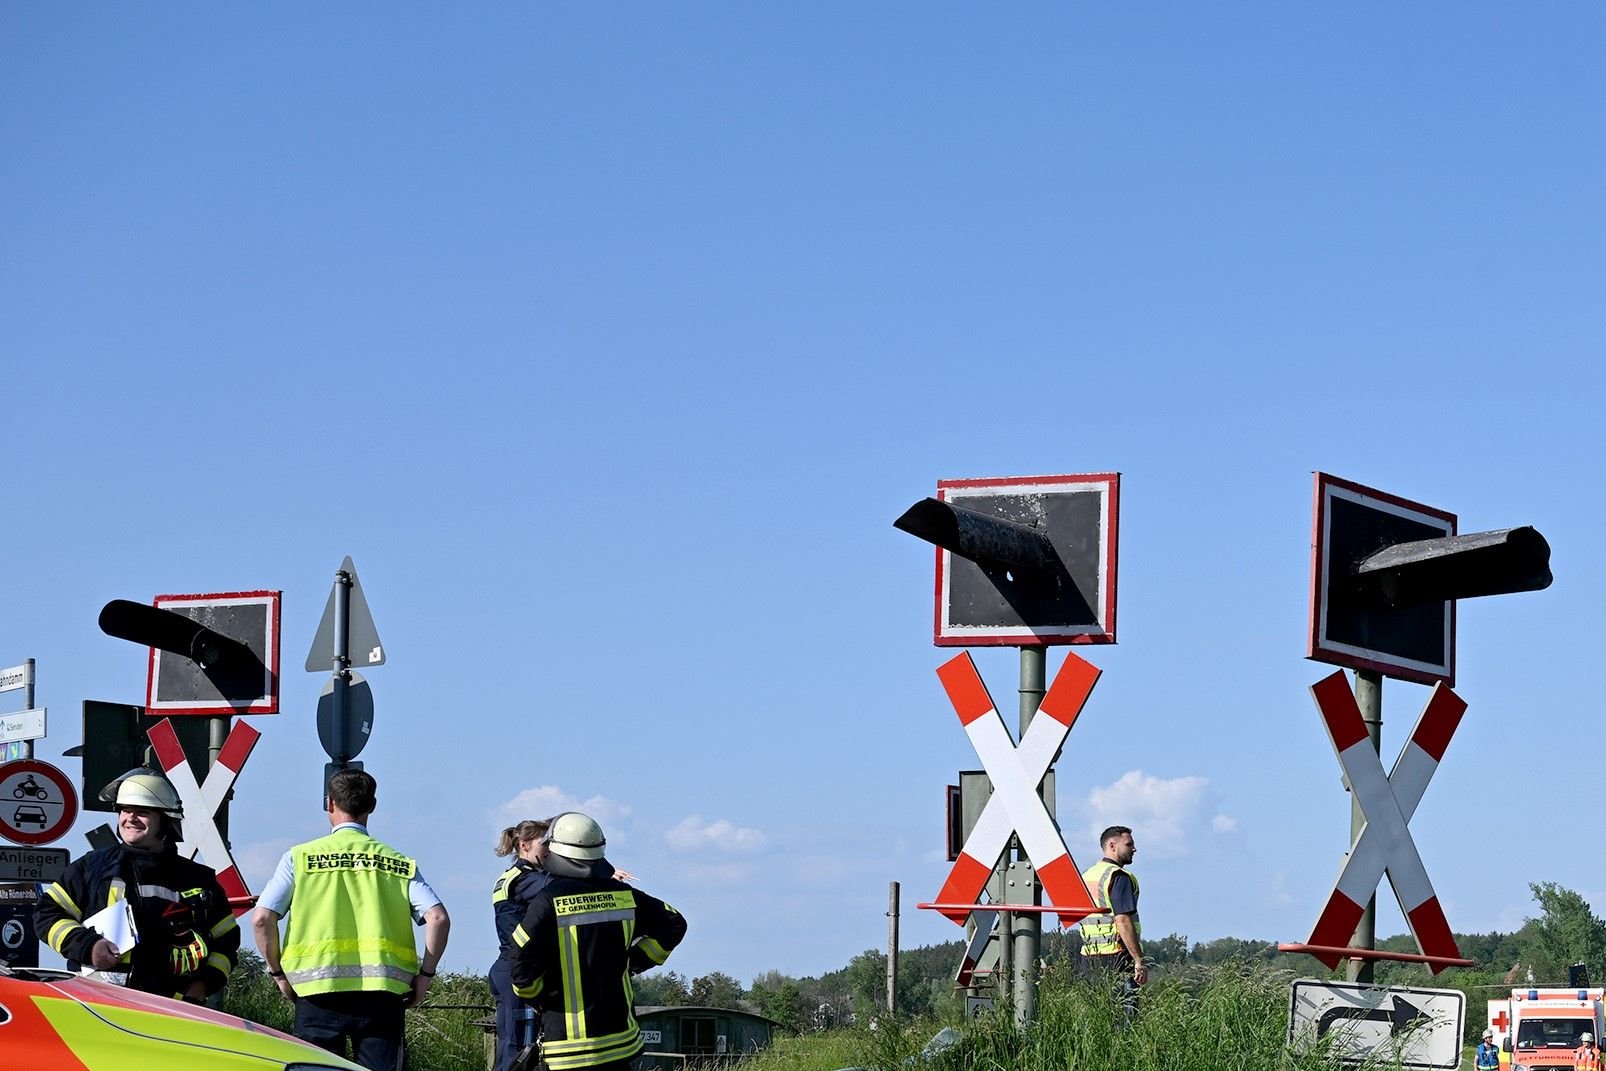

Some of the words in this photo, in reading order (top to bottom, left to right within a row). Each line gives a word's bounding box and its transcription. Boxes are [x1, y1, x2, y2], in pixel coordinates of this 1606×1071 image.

[0, 851, 60, 867] Anlieger
[307, 852, 411, 869] EINSATZLEITER
[17, 865, 43, 878] frei
[307, 860, 410, 876] FEUERWEHR
[555, 893, 615, 907] FEUERWEHR
[568, 902, 617, 912] GERLENHOFEN
[1518, 1055, 1575, 1063] RETTUNGSDIE
